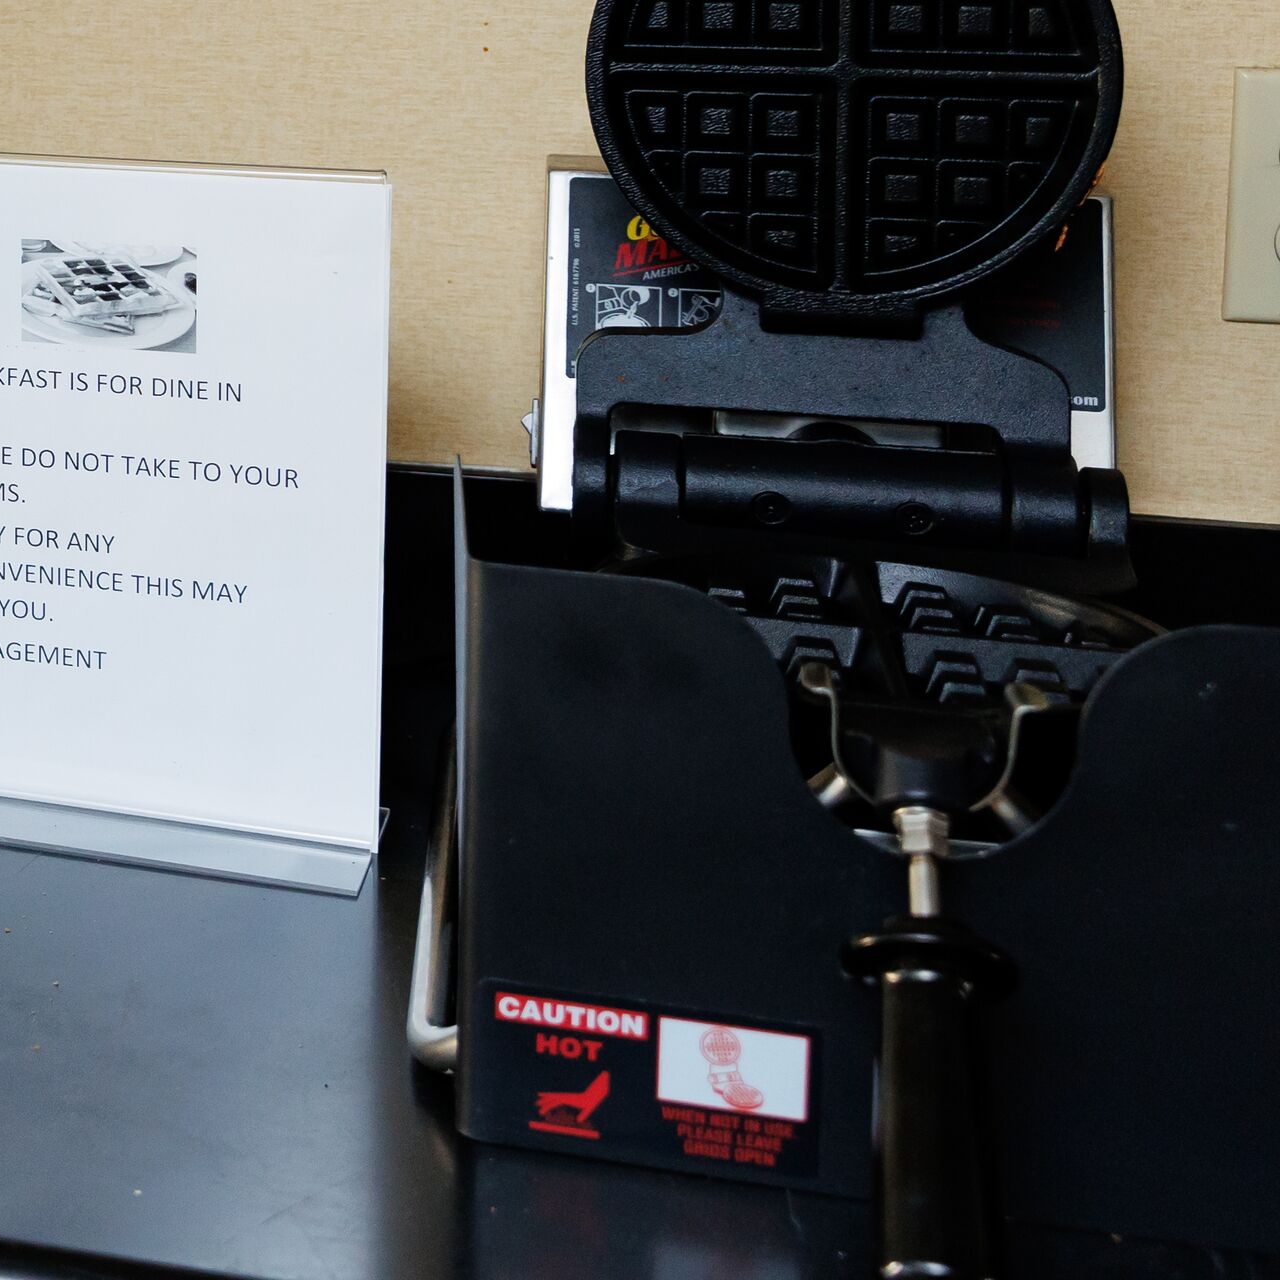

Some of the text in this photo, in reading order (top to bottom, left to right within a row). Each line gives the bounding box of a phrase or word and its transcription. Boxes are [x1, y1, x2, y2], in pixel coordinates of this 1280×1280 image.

[70, 371, 89, 392] IS
[97, 374, 143, 395] FOR
[152, 377, 209, 400] DINE
[218, 381, 242, 403] IN
[21, 447, 56, 469] DO
[65, 451, 114, 474] NOT
[121, 455, 181, 479] TAKE
[189, 461, 222, 483] TO
[229, 464, 299, 489] YOUR
[14, 527, 59, 549] FOR
[66, 532, 115, 554] ANY
[131, 574, 184, 598] THIS
[192, 580, 249, 604] MAY
[498, 995, 644, 1037] CAUTION
[536, 1032, 604, 1061] HOT
[661, 1106, 705, 1124] WHEN
[676, 1122, 732, 1144] PLEASE
